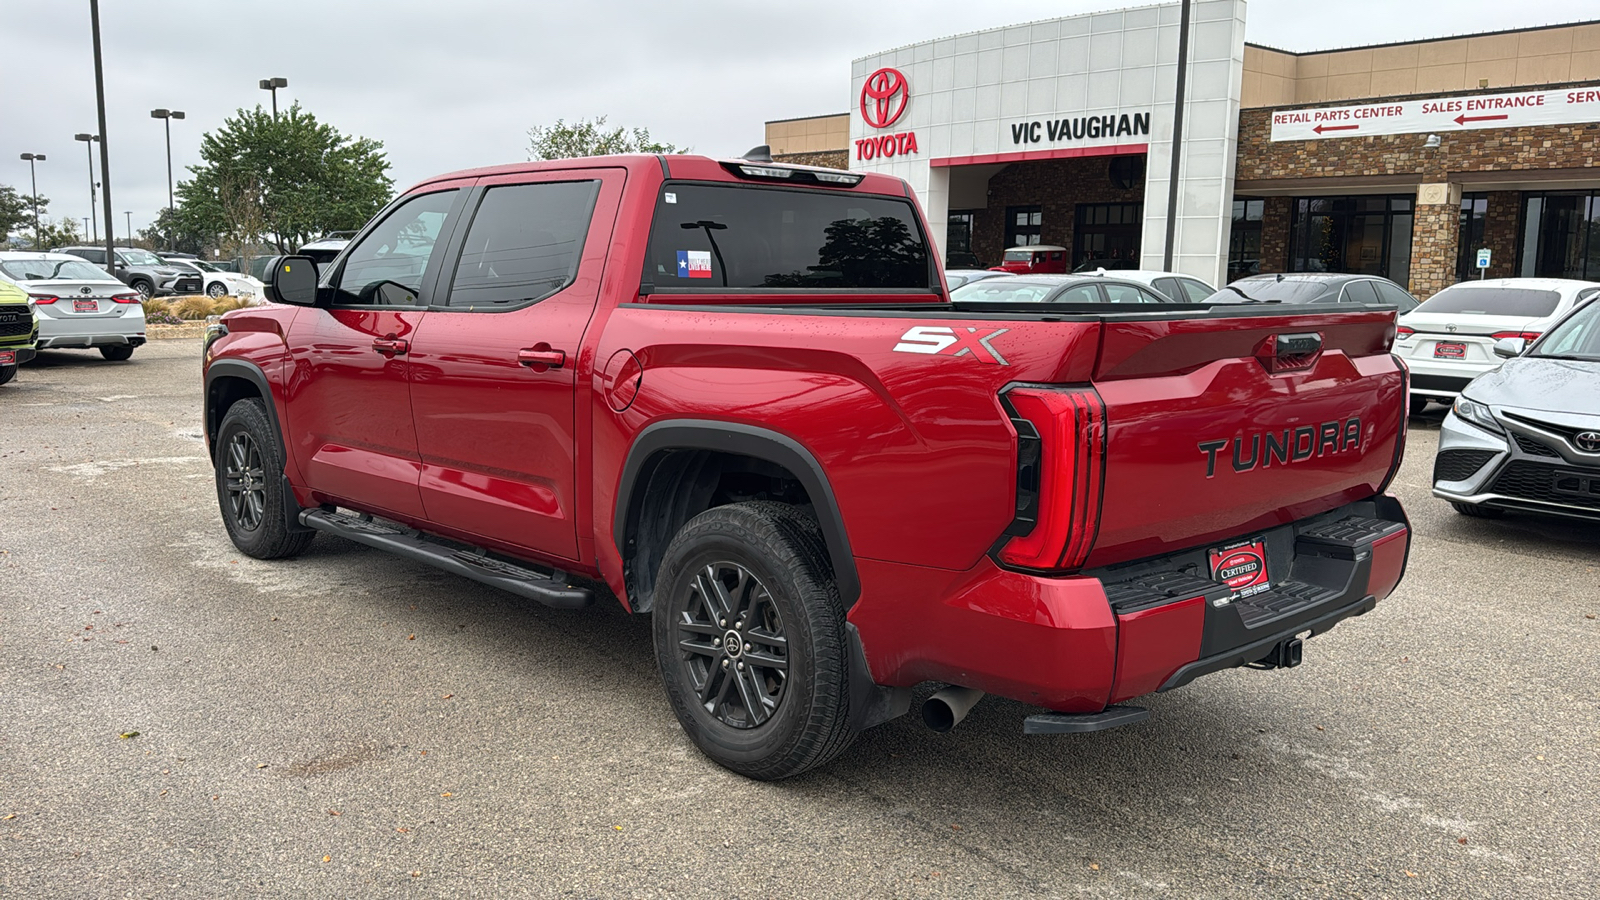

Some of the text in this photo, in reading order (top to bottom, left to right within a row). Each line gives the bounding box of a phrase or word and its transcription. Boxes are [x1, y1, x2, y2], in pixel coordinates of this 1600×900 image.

[1273, 105, 1403, 125] RETAIL PARTS CENTER
[1421, 94, 1545, 114] SALES ENTRANCE
[1011, 112, 1150, 144] VIC VAUGHAN
[855, 131, 918, 161] TOYOTA
[1197, 416, 1361, 479] TUNDRA
[1221, 562, 1257, 579] CERTIFIED
